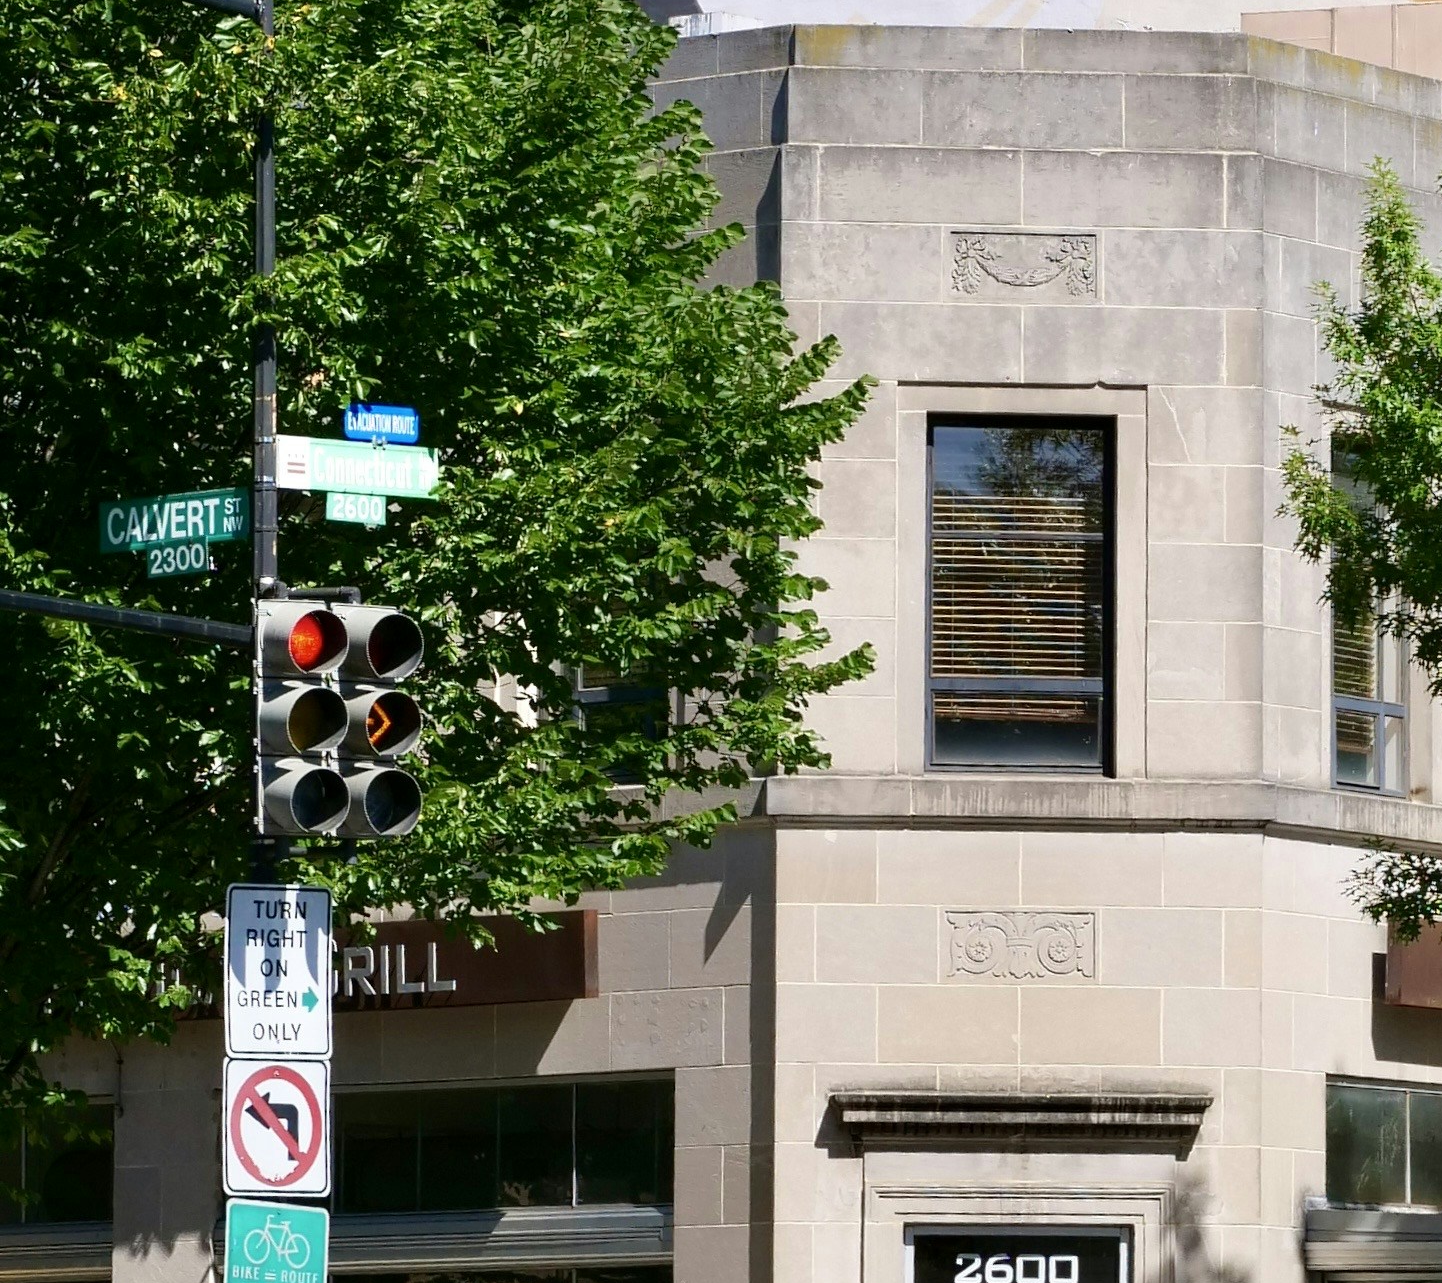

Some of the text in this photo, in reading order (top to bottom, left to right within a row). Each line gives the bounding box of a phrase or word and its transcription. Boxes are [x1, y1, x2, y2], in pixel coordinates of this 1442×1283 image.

[347, 411, 416, 436] EVACUATION ROUTE
[313, 447, 412, 490] Connecticut
[332, 494, 383, 522] 2600
[107, 497, 242, 545] CALVERT ST
[223, 515, 244, 534] NW
[150, 544, 205, 575] 2300
[253, 900, 308, 920] TURN
[246, 928, 308, 949] RIGHT
[260, 958, 288, 978] ON
[237, 989, 298, 1008] GREEN
[252, 1022, 302, 1041] ONLY
[232, 1265, 260, 1280] BIKE
